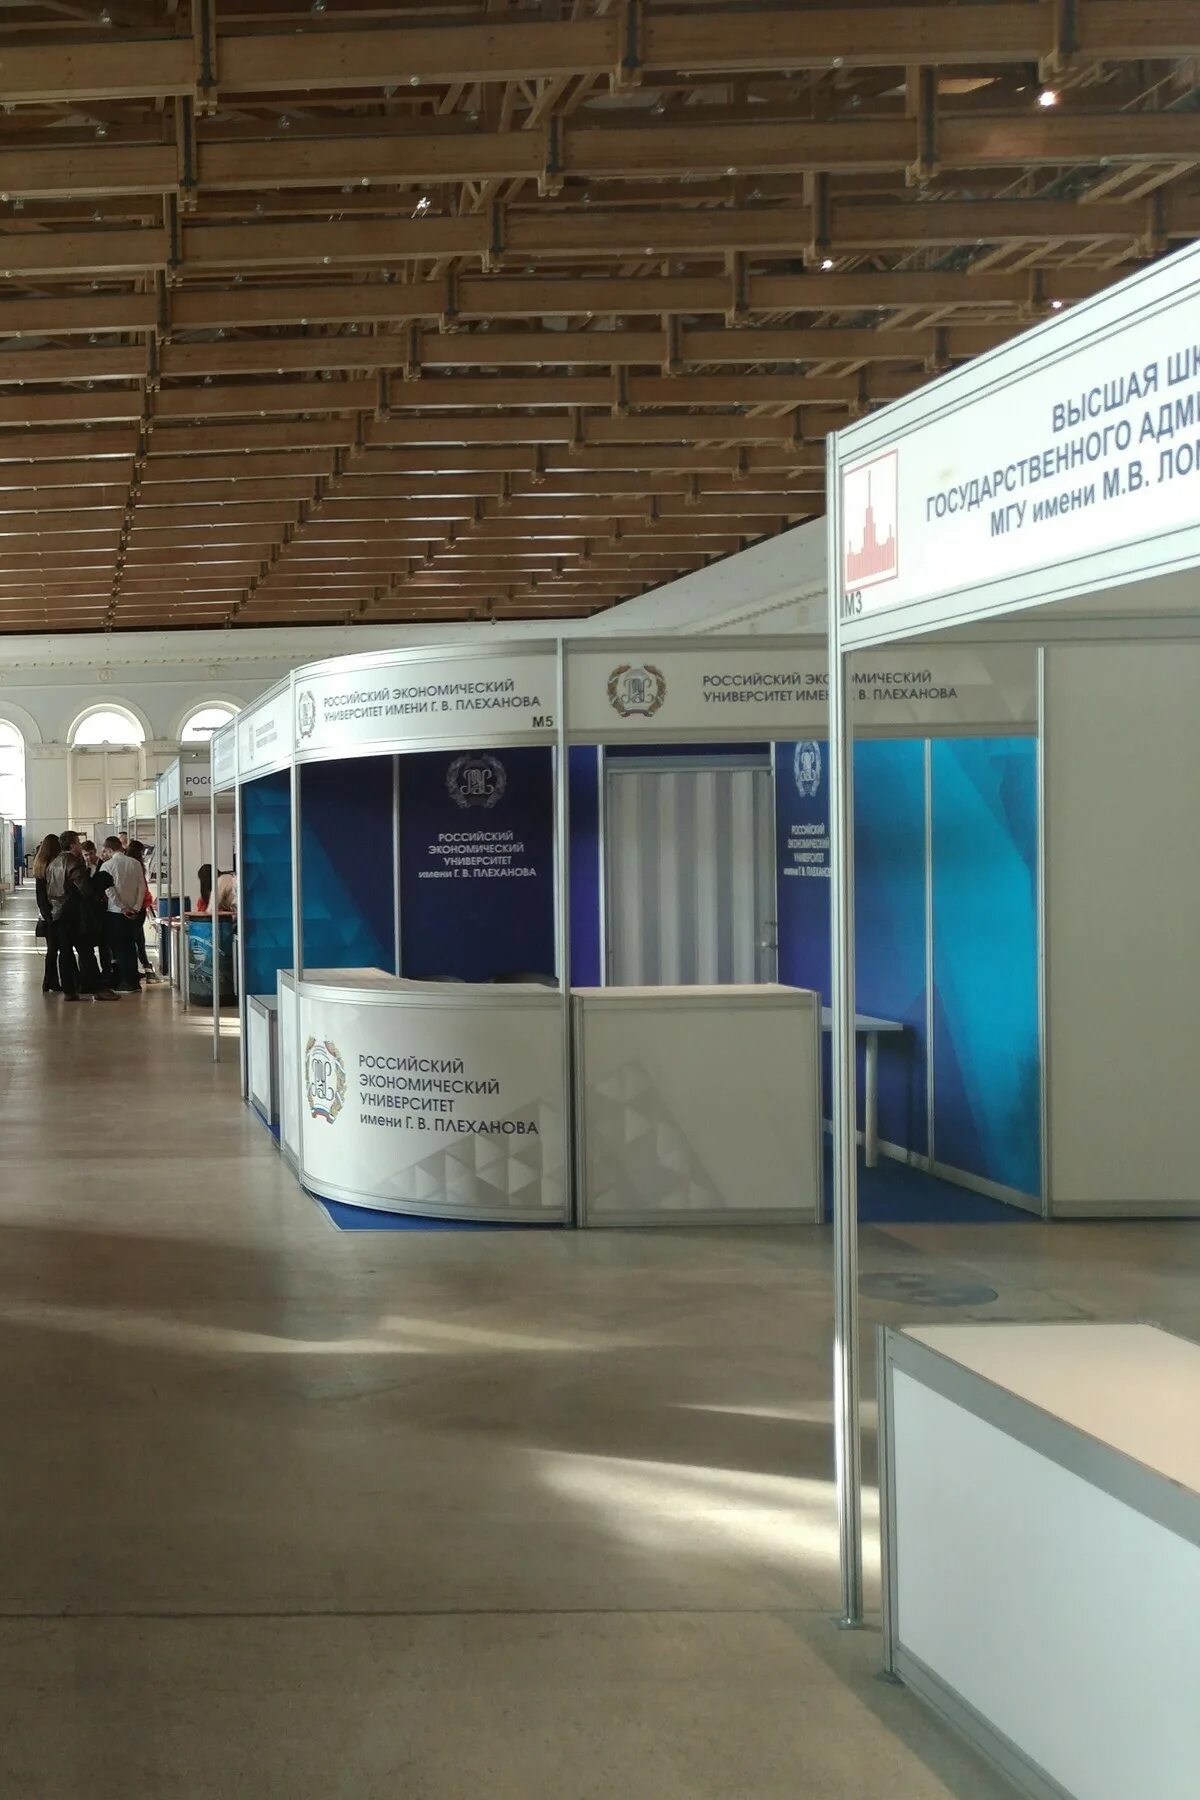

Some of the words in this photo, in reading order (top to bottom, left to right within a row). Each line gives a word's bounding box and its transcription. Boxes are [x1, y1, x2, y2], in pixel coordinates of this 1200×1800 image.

[1052, 362, 1158, 433] ВЫСШАЯ
[926, 419, 1132, 521] ГОСУДАРСТВЕННОГО
[1139, 390, 1200, 443] АДМ
[990, 500, 1028, 537] МГУ
[1033, 484, 1096, 523] имени
[1102, 459, 1150, 500] М.В.
[1157, 439, 1200, 483] ЛО
[703, 671, 801, 686] РОССИЙСКИЙ
[324, 687, 390, 708] РОССИЙСКИЙ
[392, 678, 515, 701] ЭКОНОМИЧЕСКИЙ
[703, 690, 792, 703] УНИВЕРСИТЕТ
[795, 689, 830, 702] ИМЕ
[873, 687, 958, 700] ПЛЕХАНОВА
[324, 705, 383, 722] УНИВЕРСИТЕТ
[385, 701, 428, 716] ИМЕНИ
[431, 701, 438, 712] Г.
[441, 700, 452, 712] В.
[455, 696, 542, 711] ПЛЕХАНОВА
[531, 715, 554, 728] М5
[438, 830, 514, 842] РОССИЙСКИЙ
[428, 842, 524, 855] ЭКОНОМИЧЕСКИЙ
[443, 856, 513, 866] УНИВЕРСИТЕТ
[418, 870, 452, 879] имени
[473, 867, 537, 878] ПЛЕХАНОВА
[359, 1055, 464, 1074] РОССИЙСКИЙ
[359, 1074, 500, 1095] ЭКОНОМИЧЕСКИЙ
[360, 1092, 455, 1113] УНИВЕРСИТЕТ
[360, 1113, 402, 1128] имени
[405, 1117, 414, 1130] Г.
[417, 1118, 431, 1131] В.
[434, 1118, 539, 1135] ПЛЕХАНОВА
